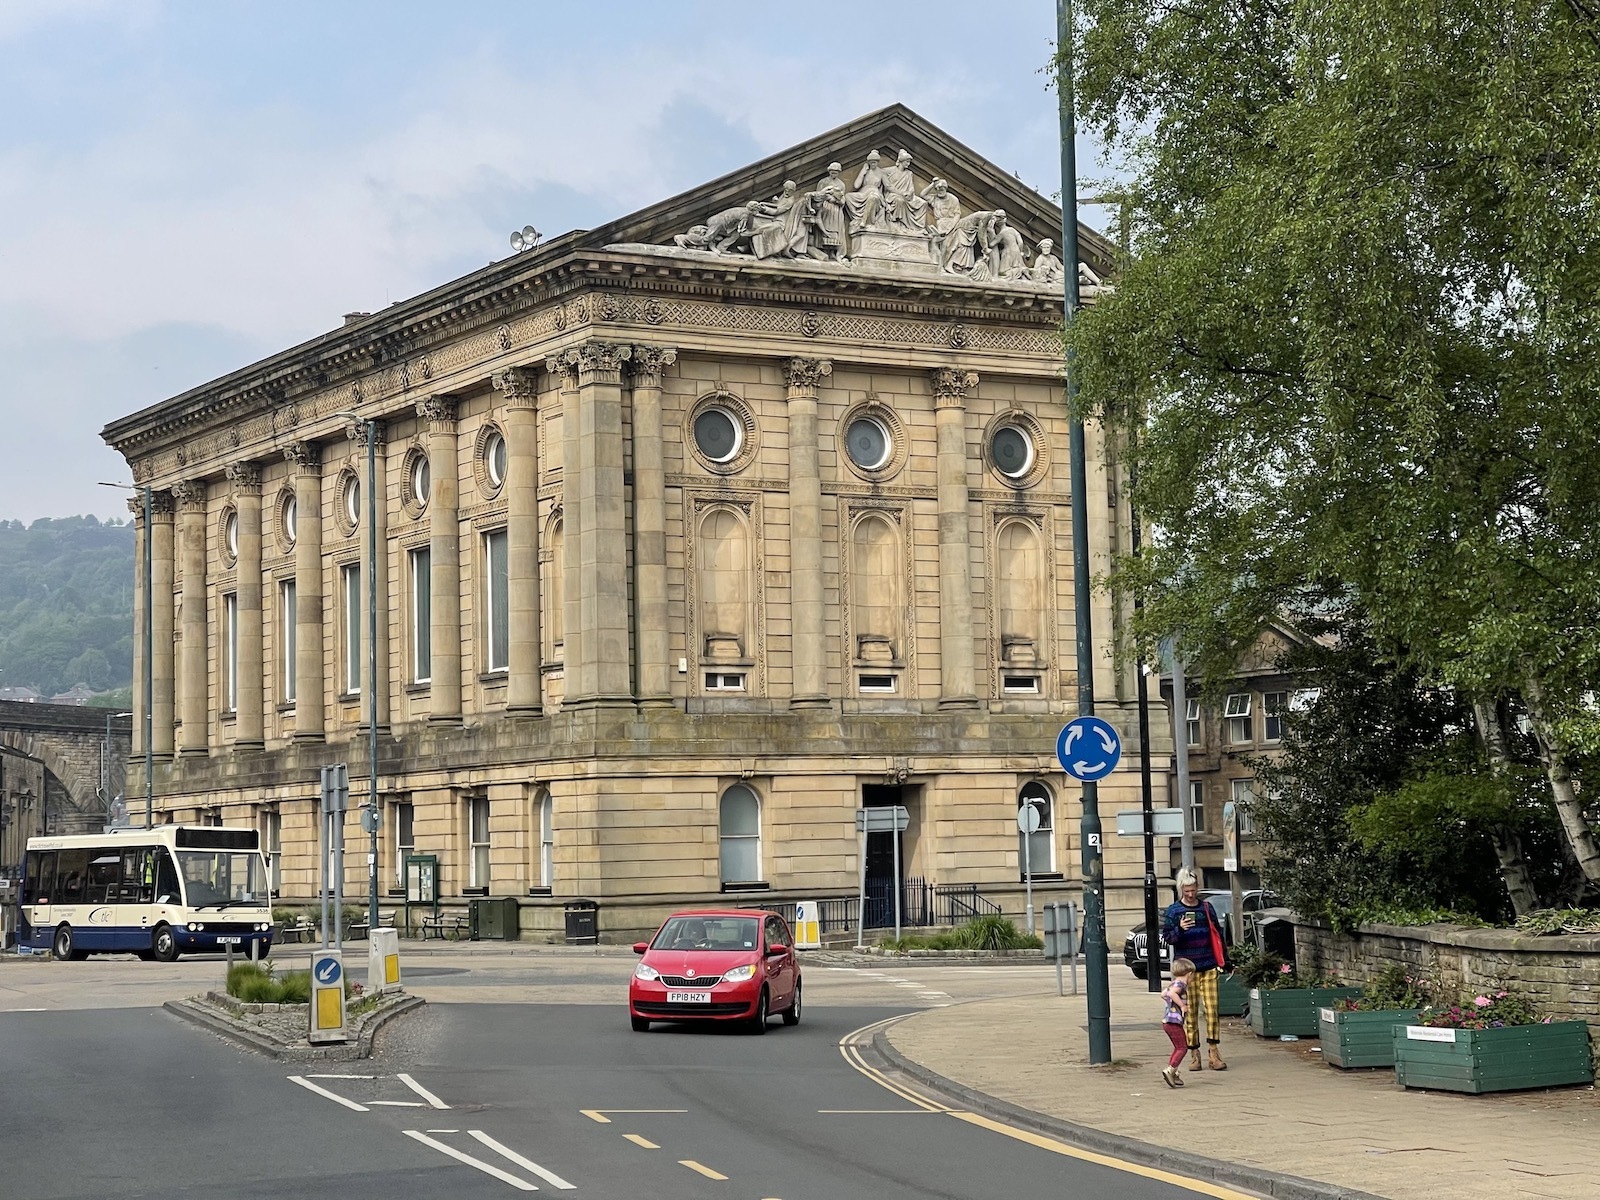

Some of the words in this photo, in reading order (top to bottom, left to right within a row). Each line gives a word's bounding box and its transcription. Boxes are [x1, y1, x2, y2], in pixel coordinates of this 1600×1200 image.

[1091, 835, 1098, 844] 2
[671, 993, 689, 1001] FP18
[690, 993, 706, 1001] HZY
